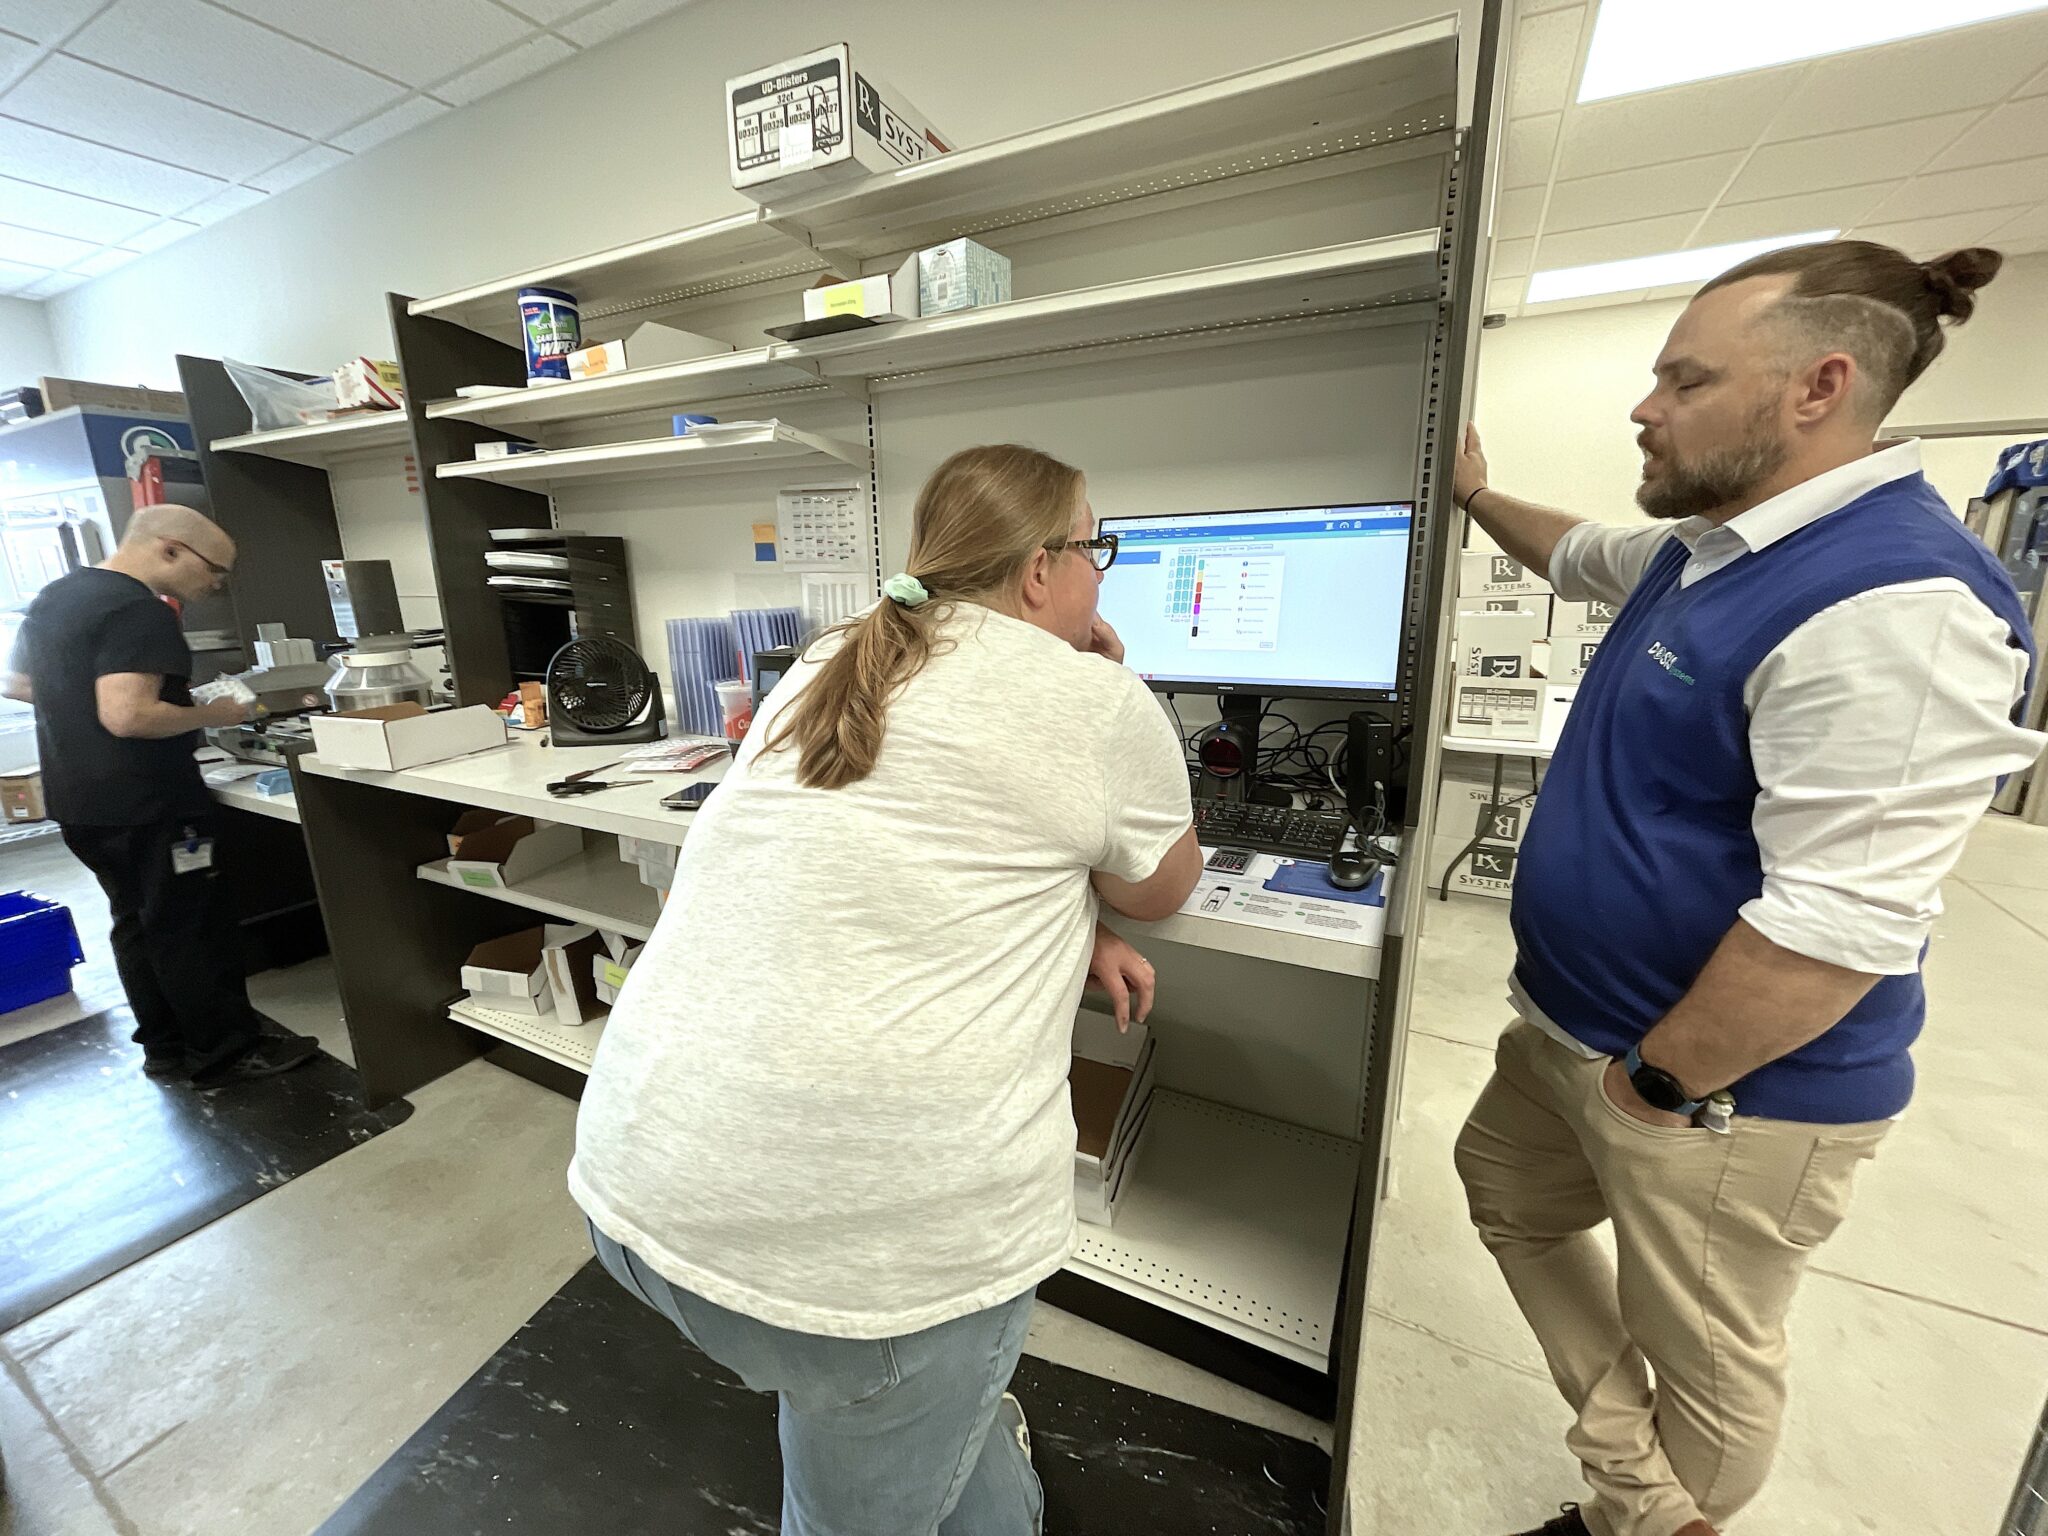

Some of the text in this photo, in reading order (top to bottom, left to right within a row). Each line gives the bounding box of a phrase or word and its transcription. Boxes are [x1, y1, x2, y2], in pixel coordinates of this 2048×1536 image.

[761, 72, 809, 95] UD-Blisters
[777, 91, 794, 104] 32ct
[885, 114, 923, 160] SYST
[540, 341, 578, 356] WIPES
[1494, 558, 1516, 577] Rx
[1483, 582, 1532, 592] SYSTEMS
[1577, 624, 1610, 632] SYST
[1471, 647, 1482, 677] SYST
[1459, 874, 1512, 889] SYSTEM
